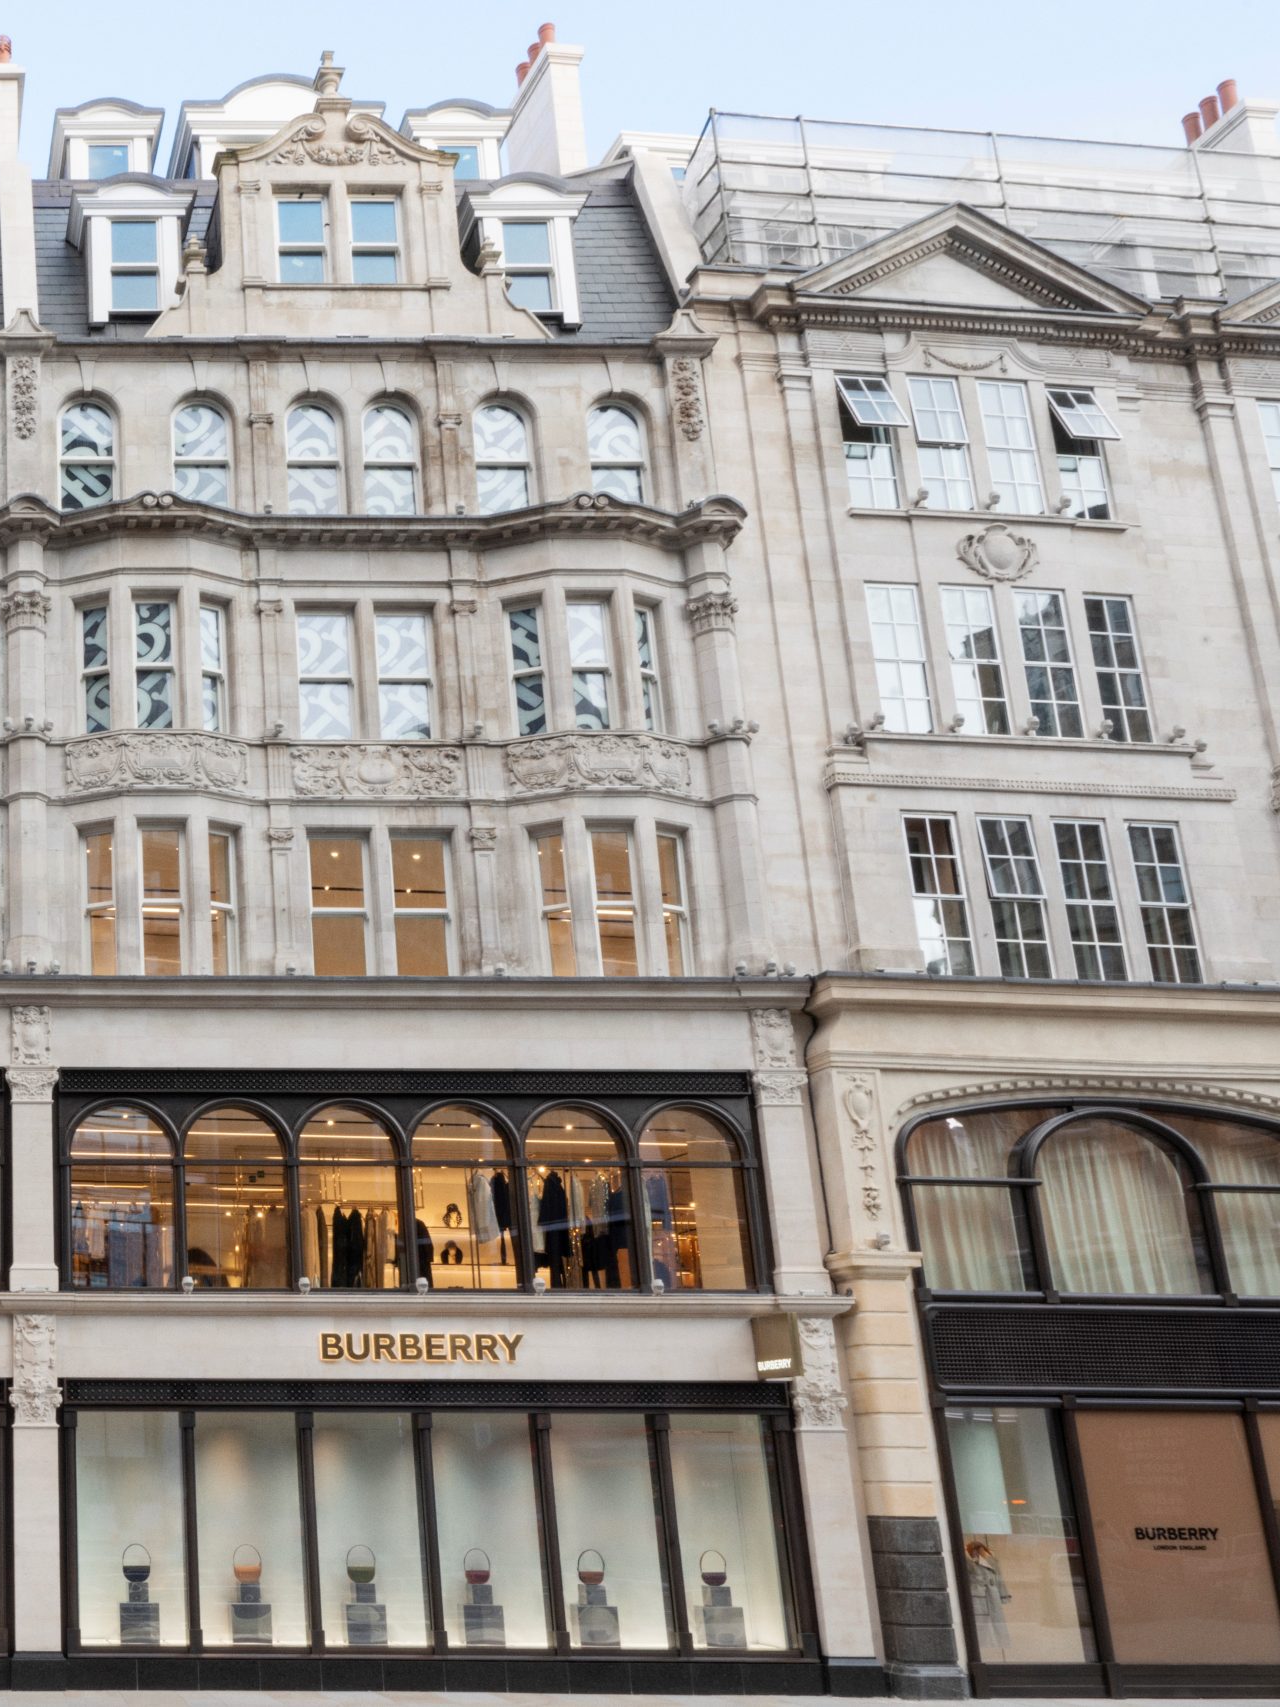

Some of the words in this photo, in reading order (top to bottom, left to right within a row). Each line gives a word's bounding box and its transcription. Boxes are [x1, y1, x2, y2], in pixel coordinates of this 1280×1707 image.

[320, 1332, 524, 1361] BURBERRY
[757, 1358, 792, 1372] BURBERRY
[1134, 1527, 1219, 1541] BURBERRY
